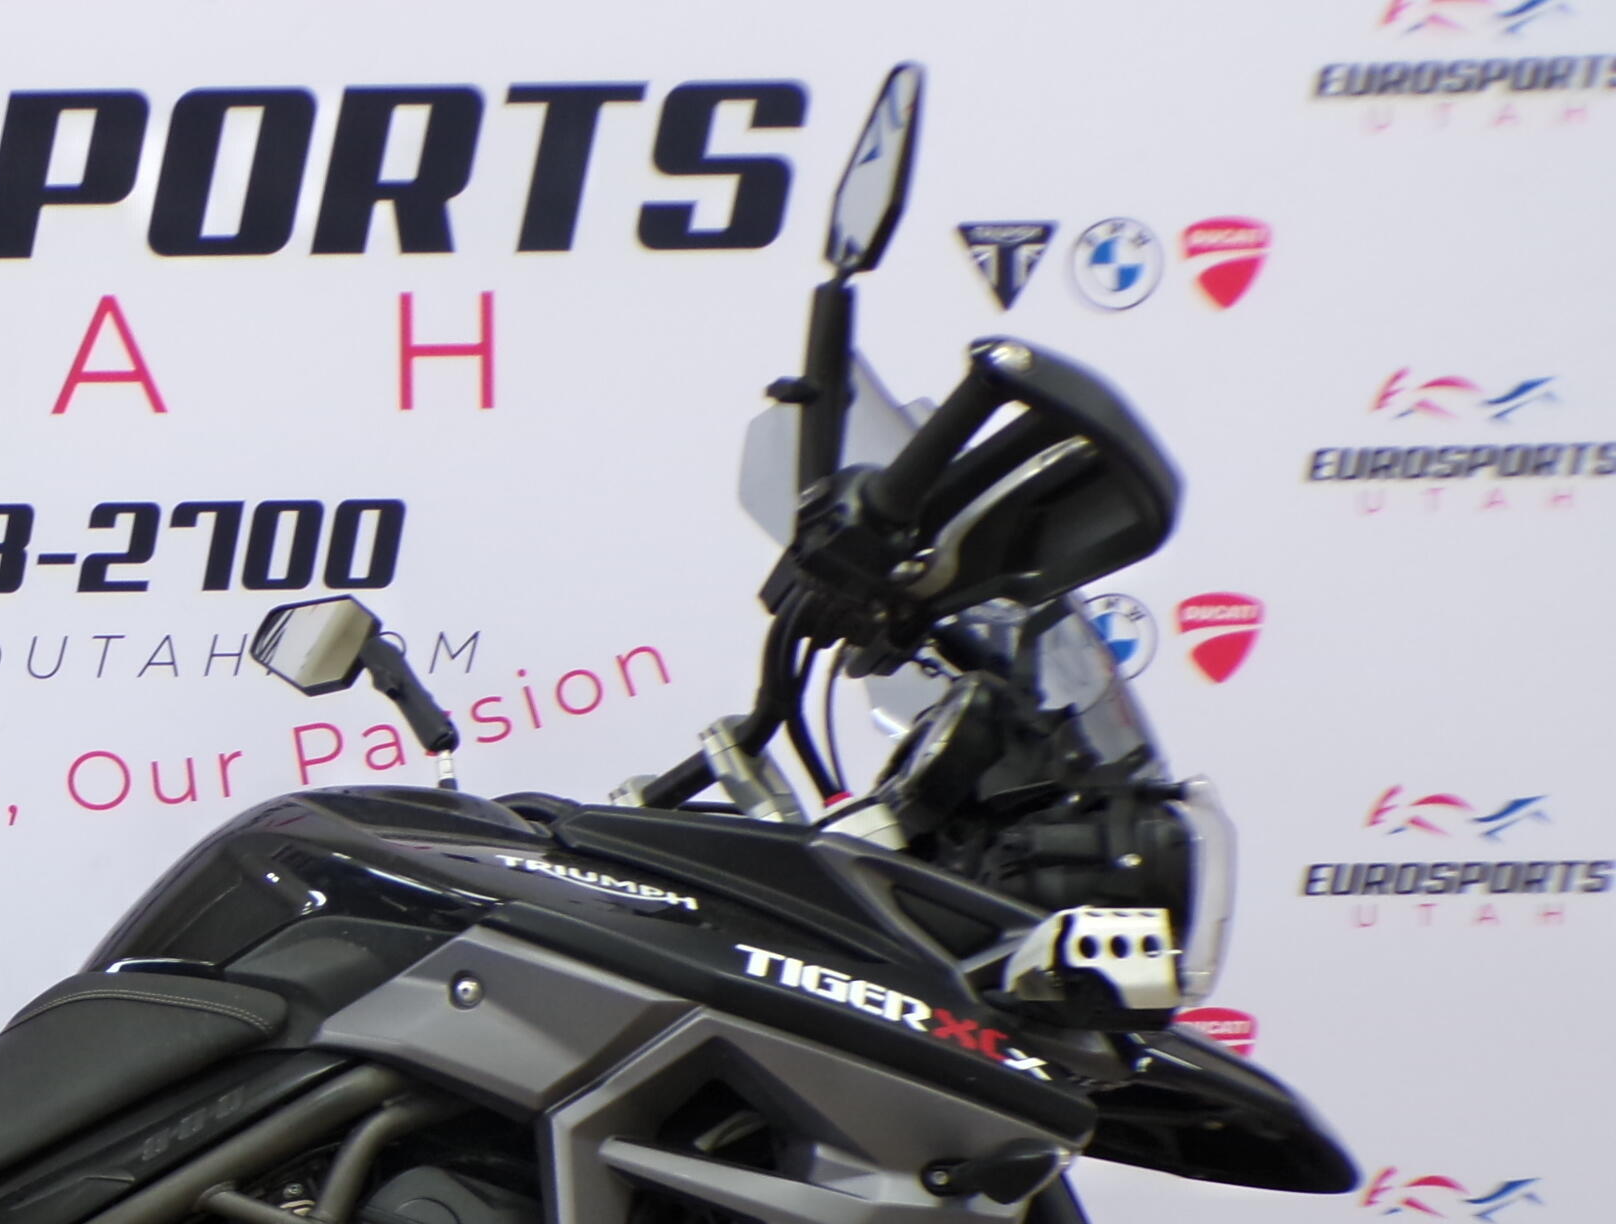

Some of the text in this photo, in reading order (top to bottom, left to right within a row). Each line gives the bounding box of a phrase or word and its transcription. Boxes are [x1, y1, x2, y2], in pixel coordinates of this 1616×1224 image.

[68, 750, 244, 812] Our
[293, 645, 672, 786] Pasion
[495, 854, 698, 911] TRIUMPH
[1304, 860, 1614, 897] EUROSPORTS
[1351, 903, 1566, 929] UTAH
[735, 943, 933, 1032] TIGER
